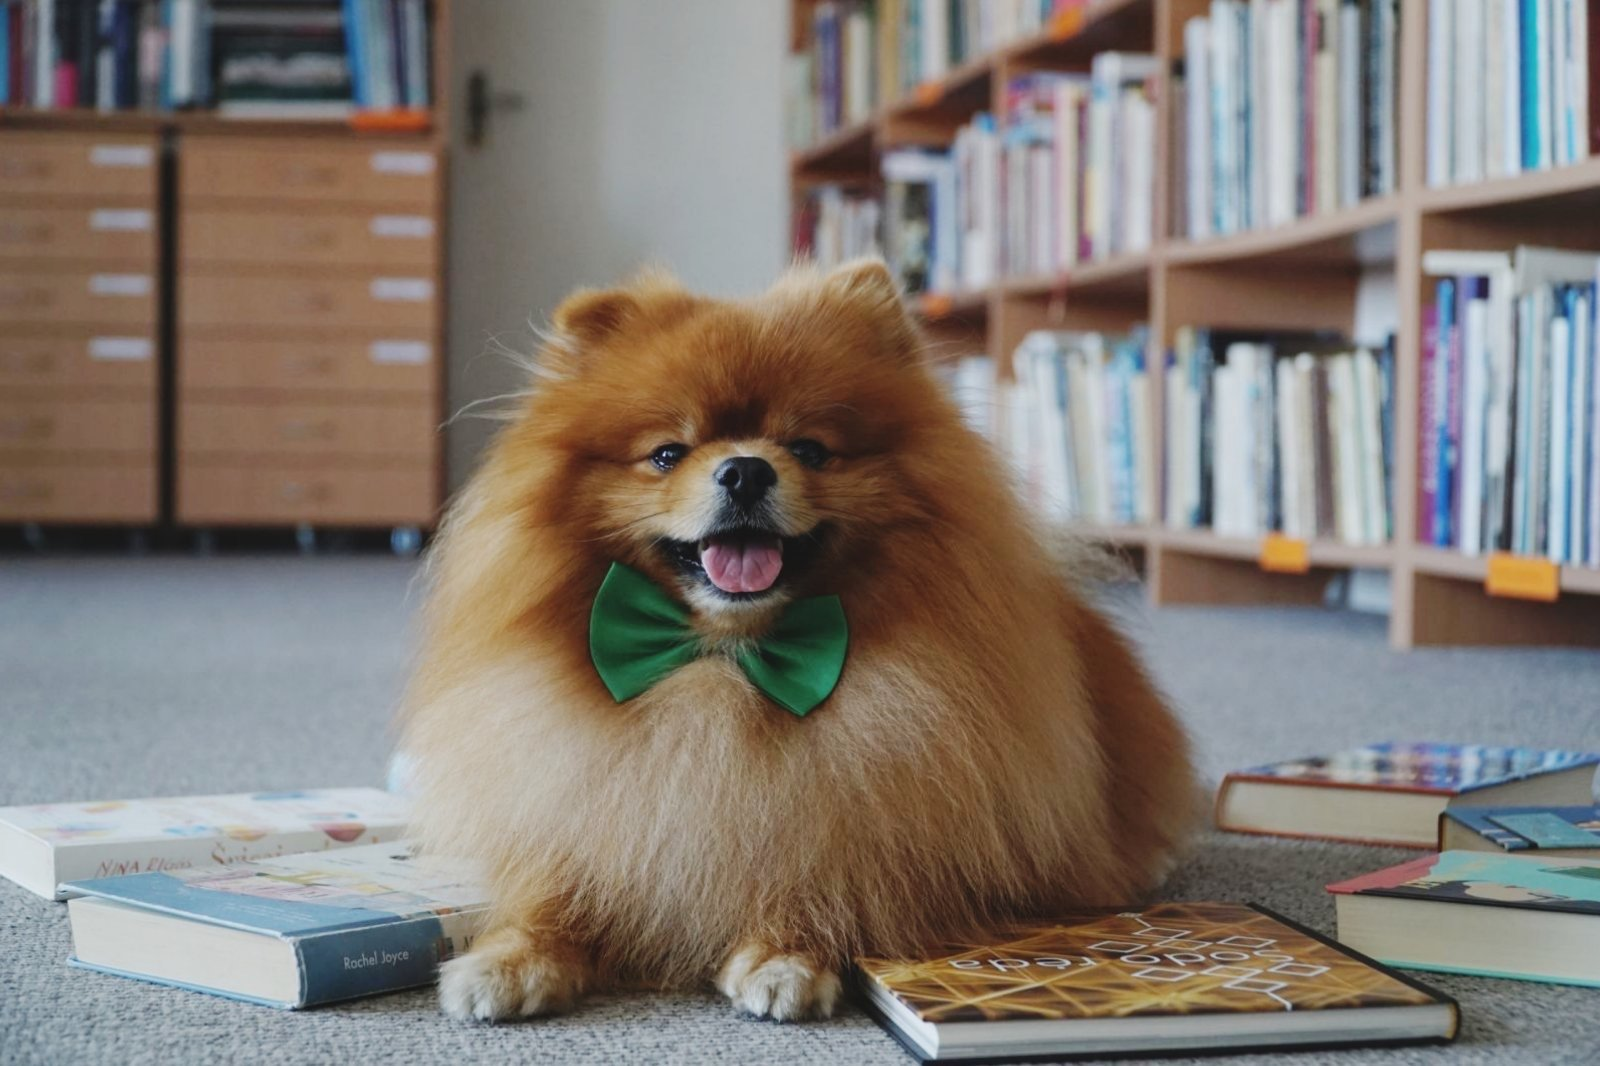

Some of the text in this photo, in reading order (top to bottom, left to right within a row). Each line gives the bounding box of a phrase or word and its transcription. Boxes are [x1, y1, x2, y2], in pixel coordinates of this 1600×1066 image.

[343, 950, 409, 970] Rachel Joyce
[1120, 949, 1294, 966] Sodo
